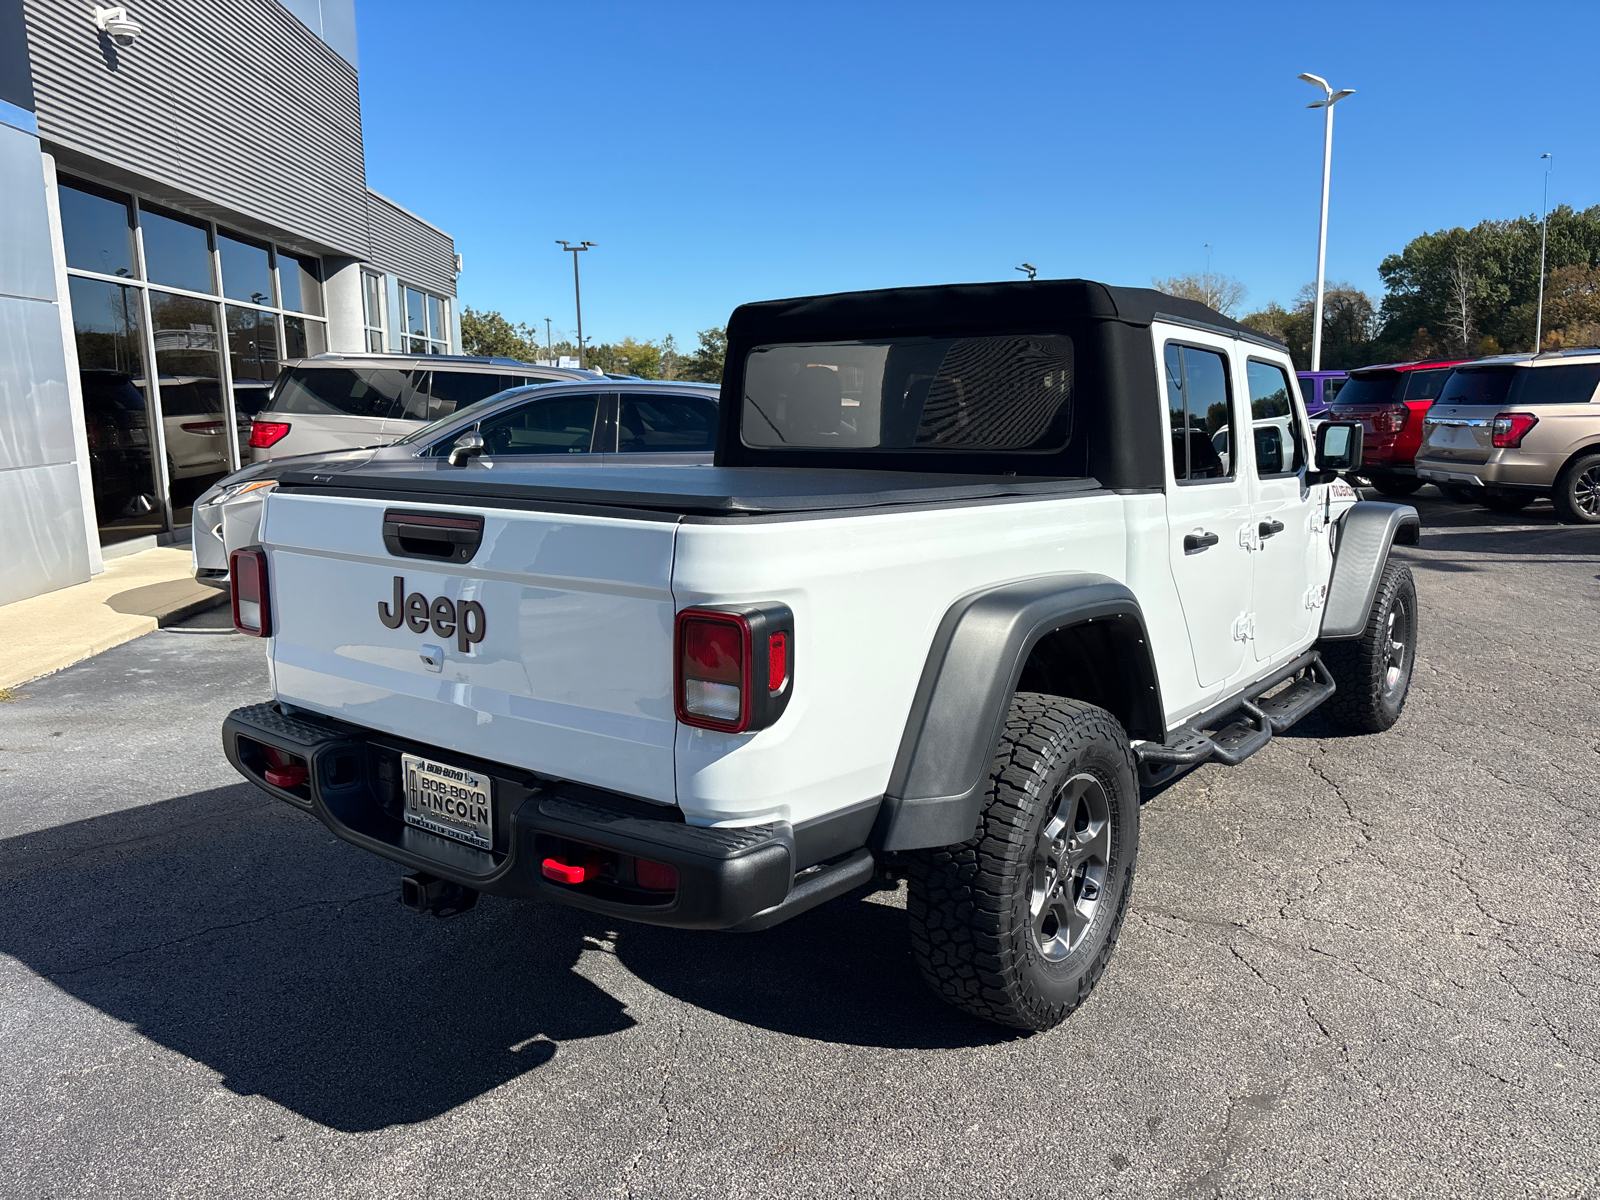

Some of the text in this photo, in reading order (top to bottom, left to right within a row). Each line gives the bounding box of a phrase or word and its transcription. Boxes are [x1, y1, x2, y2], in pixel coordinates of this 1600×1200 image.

[378, 576, 486, 653] Jeep
[426, 763, 464, 781] BOB-BOYD
[421, 777, 486, 805] BOB-BOYD
[420, 789, 488, 825] LINCOLN
[441, 812, 477, 830] COLUMBUS
[408, 816, 437, 831] LINCOLN
[448, 828, 490, 849] COLUMBUS
